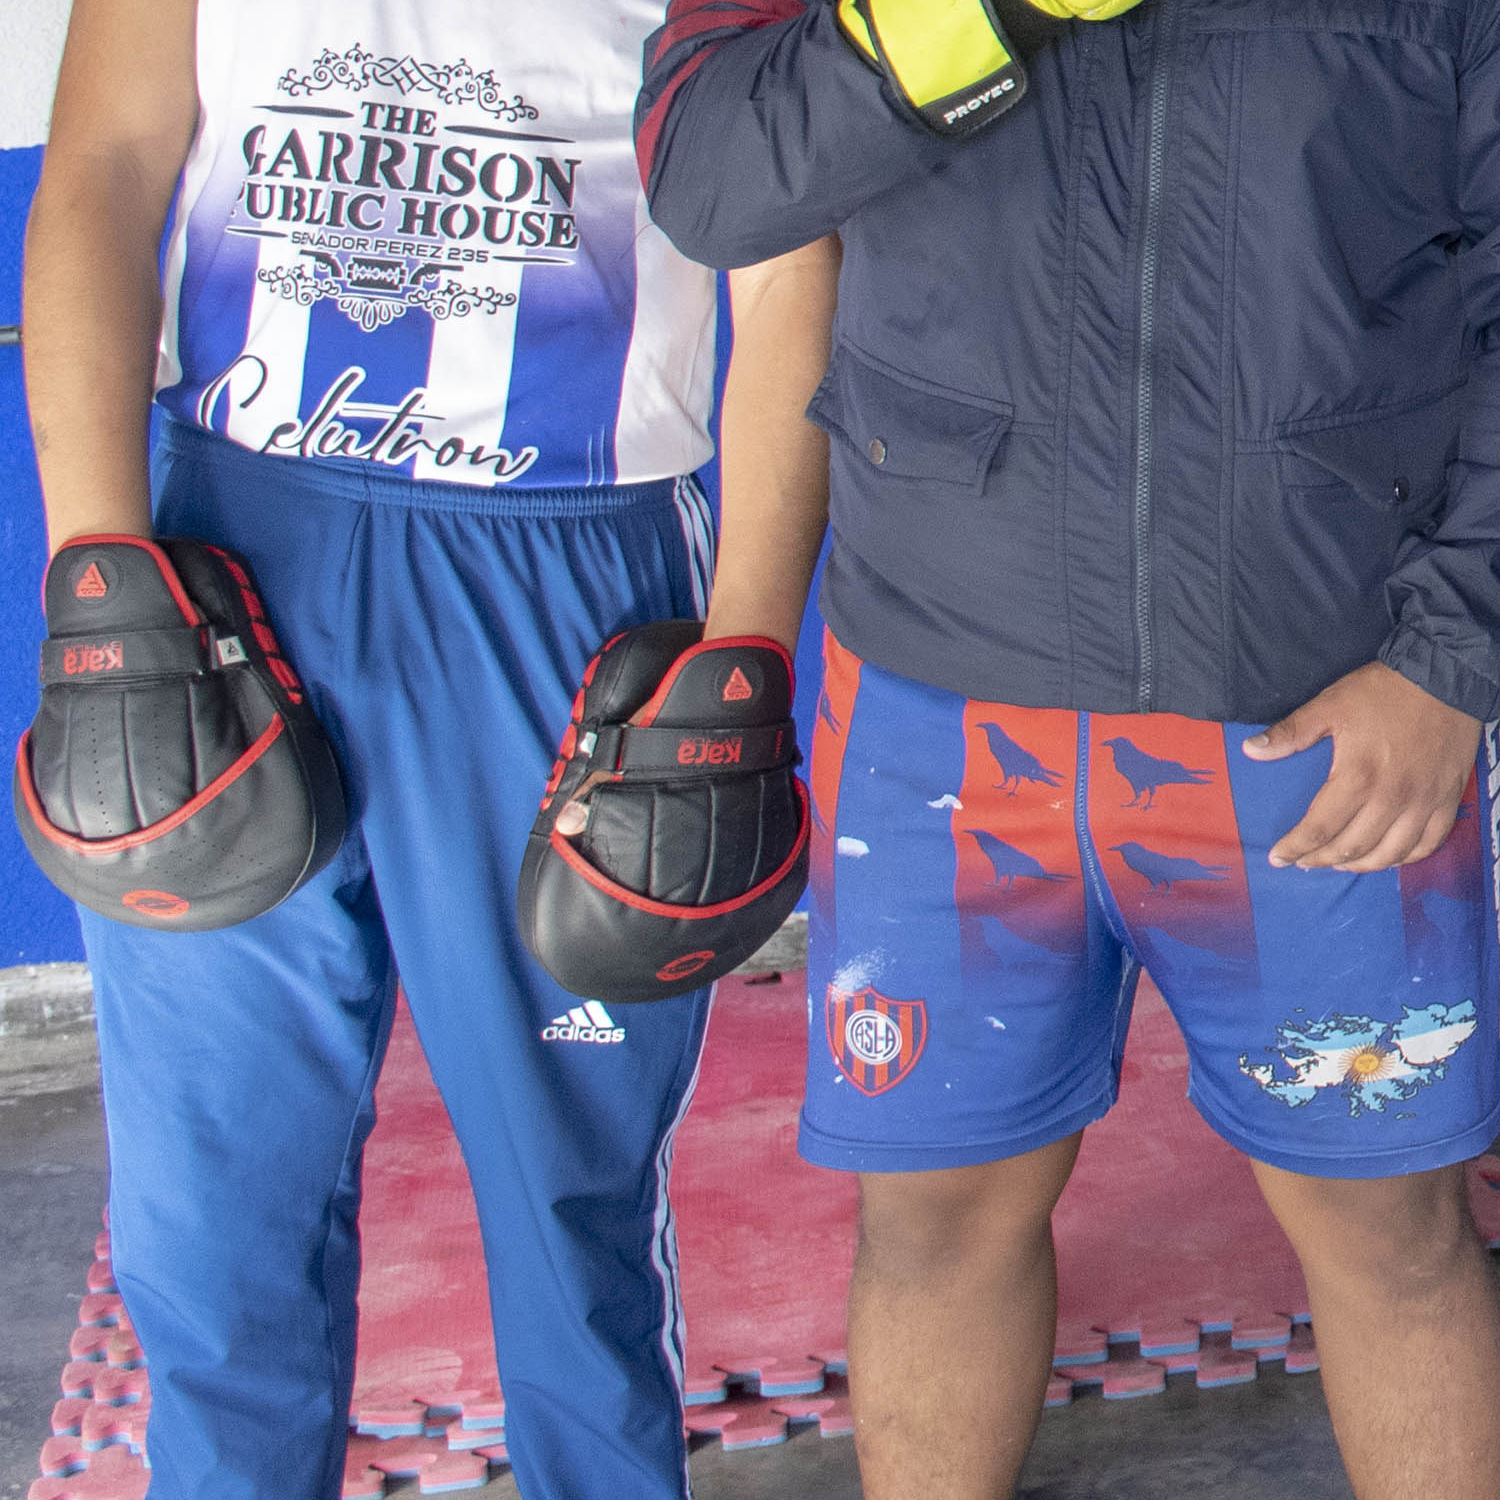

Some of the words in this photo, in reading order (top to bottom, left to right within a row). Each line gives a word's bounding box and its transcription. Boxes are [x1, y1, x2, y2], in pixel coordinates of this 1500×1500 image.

[360, 100, 439, 138] THE
[943, 78, 1016, 125] PROYEC
[242, 123, 583, 209] GARRISON
[236, 181, 387, 232] UBLIC
[397, 197, 581, 250] HOUSE
[376, 238, 443, 260] PEREZ
[450, 248, 490, 264] 235
[542, 1024, 626, 1044] adidas
